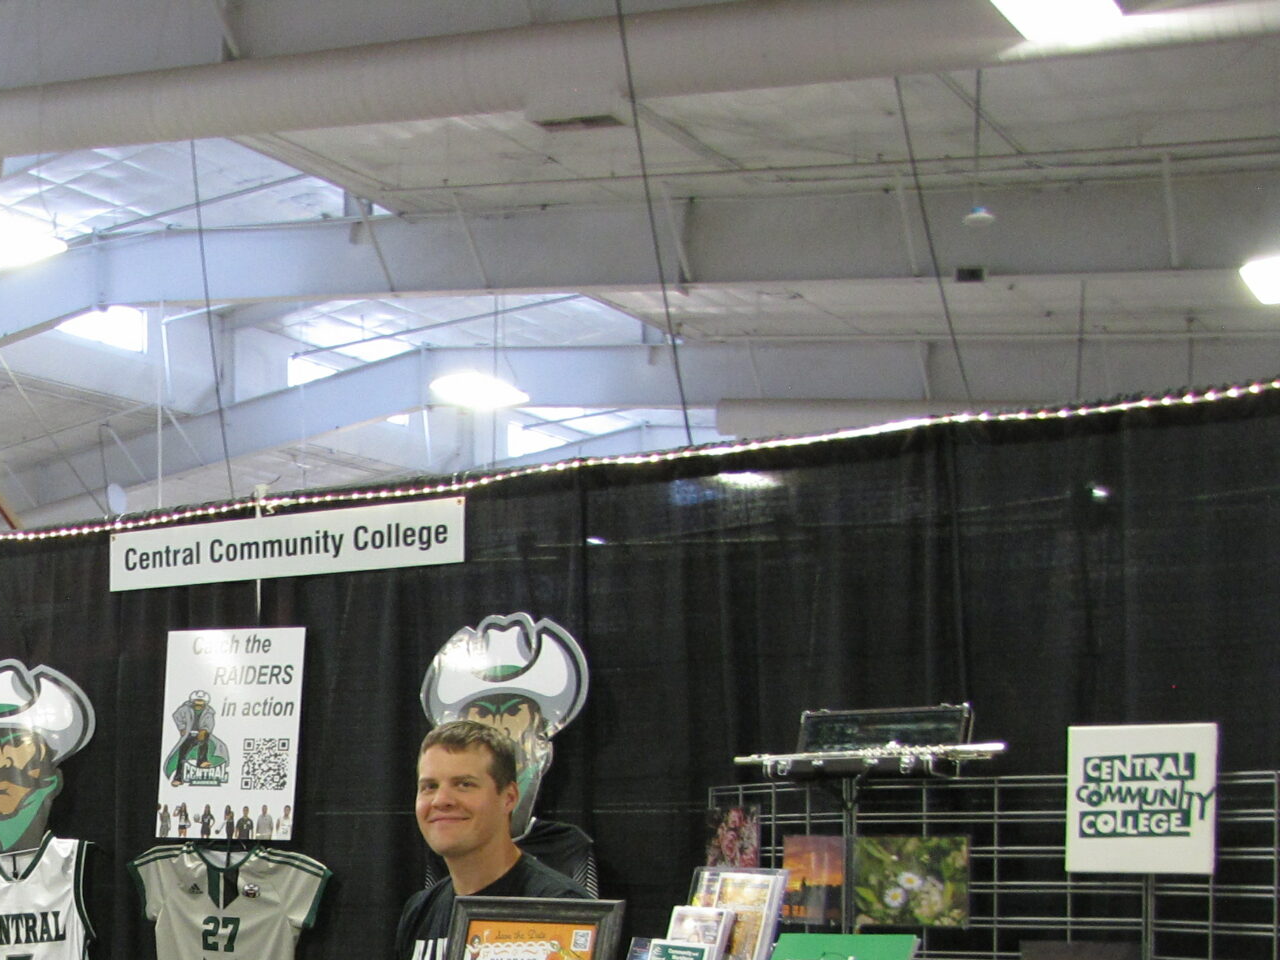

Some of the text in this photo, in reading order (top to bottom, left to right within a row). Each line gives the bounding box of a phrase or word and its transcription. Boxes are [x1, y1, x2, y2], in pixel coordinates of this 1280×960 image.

[124, 520, 449, 572] Central Community College
[245, 633, 272, 654] the
[213, 664, 294, 686] RAIDERS
[221, 696, 295, 717] in action
[183, 761, 229, 783] CENTRAL
[1084, 754, 1192, 783] CENTRAL
[1076, 780, 1217, 820] COMMUNITY
[1080, 810, 1191, 837] COLLEGE
[201, 915, 241, 953] 27
